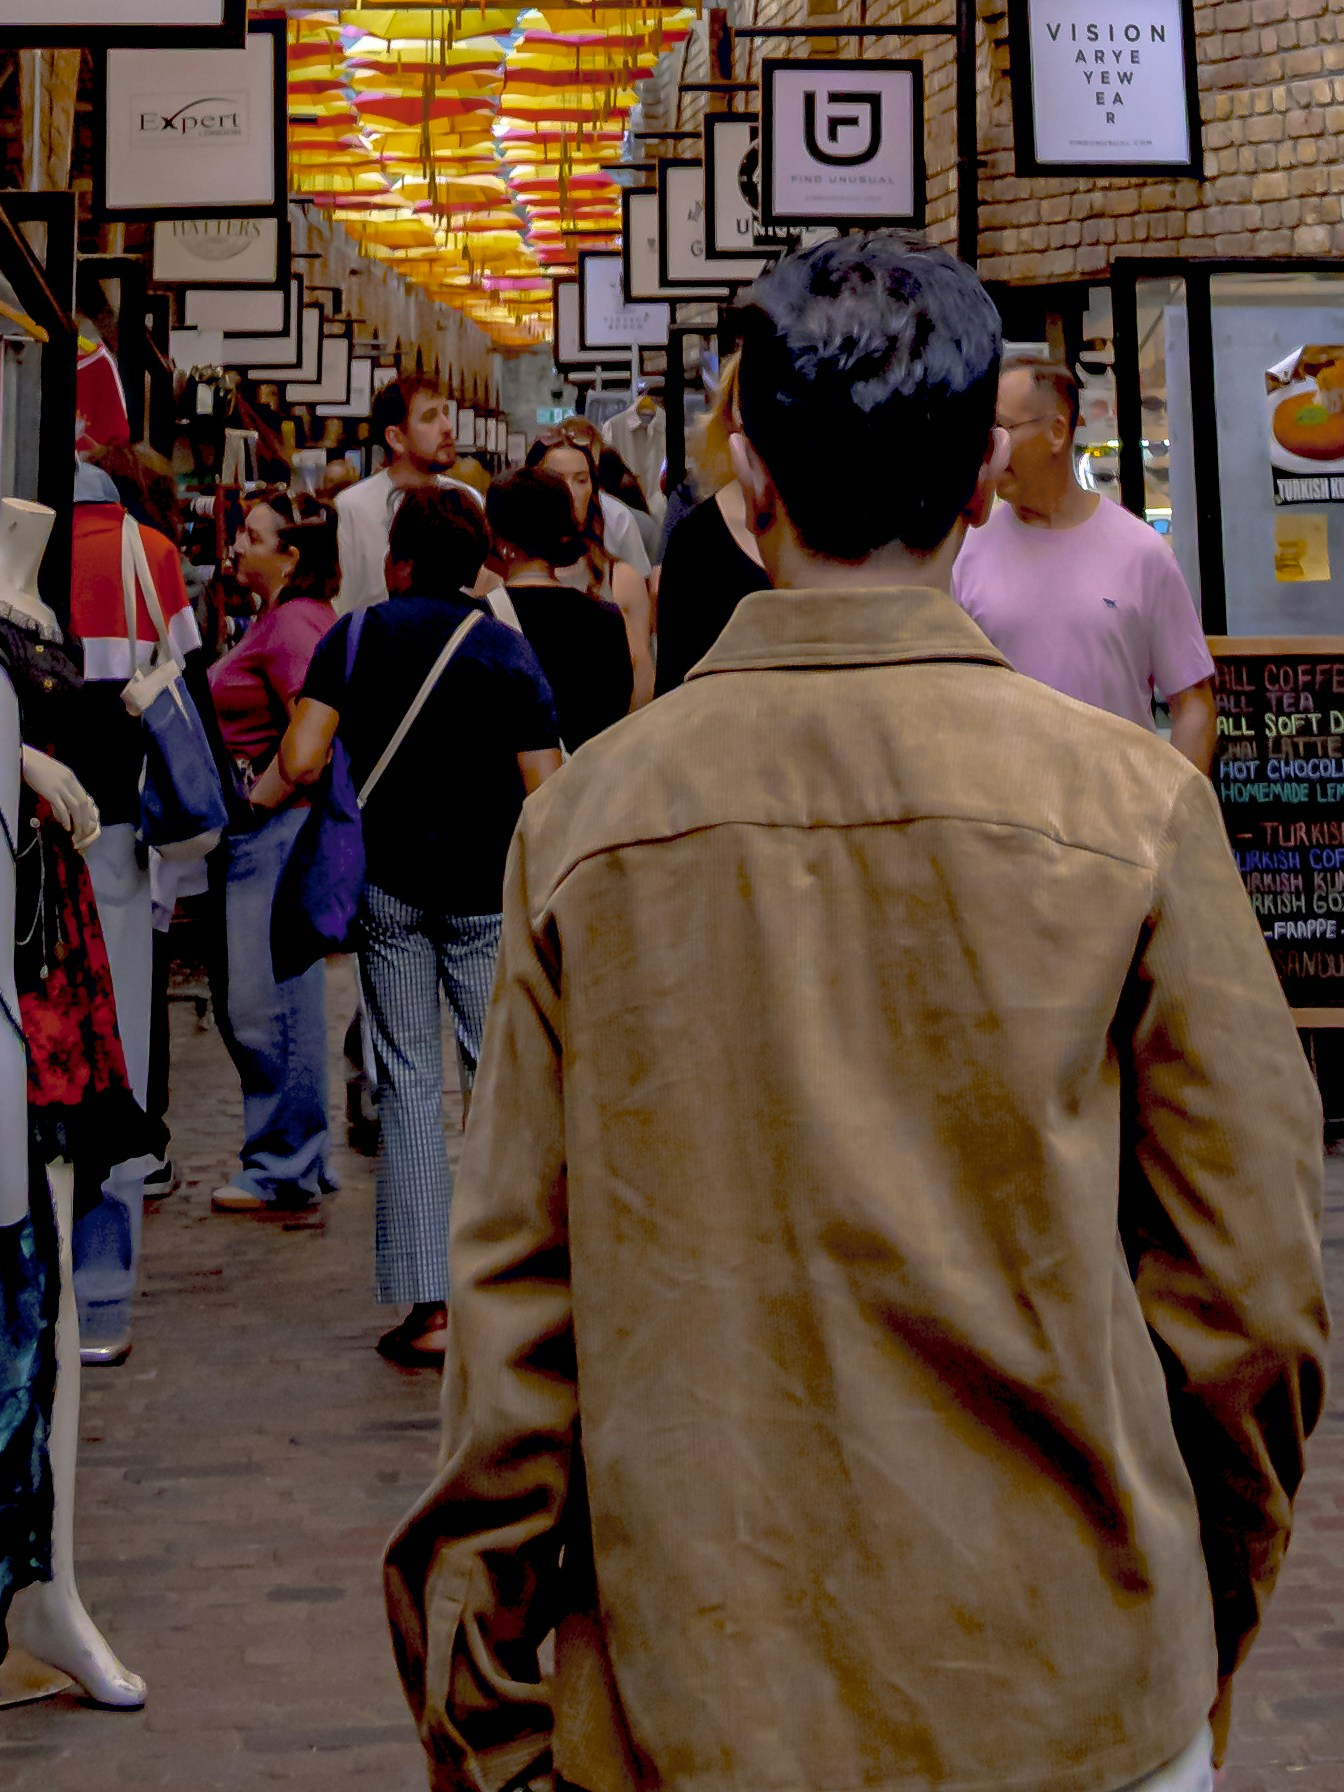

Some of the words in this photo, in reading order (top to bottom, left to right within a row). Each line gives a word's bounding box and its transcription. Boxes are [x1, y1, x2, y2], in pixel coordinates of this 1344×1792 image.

[1045, 22, 1166, 43] VISION
[1075, 49, 1141, 65] ARYE
[1083, 70, 1134, 86] YEW
[139, 112, 240, 135] Expert
[1106, 111, 1116, 125] R
[1276, 477, 1330, 502] TURKISH
[1214, 665, 1256, 691] ALL
[1215, 693, 1254, 714] ALL
[1265, 691, 1315, 714] TEA
[1216, 715, 1255, 736] ALL
[1264, 713, 1322, 738] SOFT
[1268, 735, 1343, 759] LATTE
[1220, 760, 1261, 780] HOT
[1221, 782, 1310, 803] HOMEMADE
[1235, 848, 1301, 872] URKISH
[1251, 892, 1306, 915] RKISH
